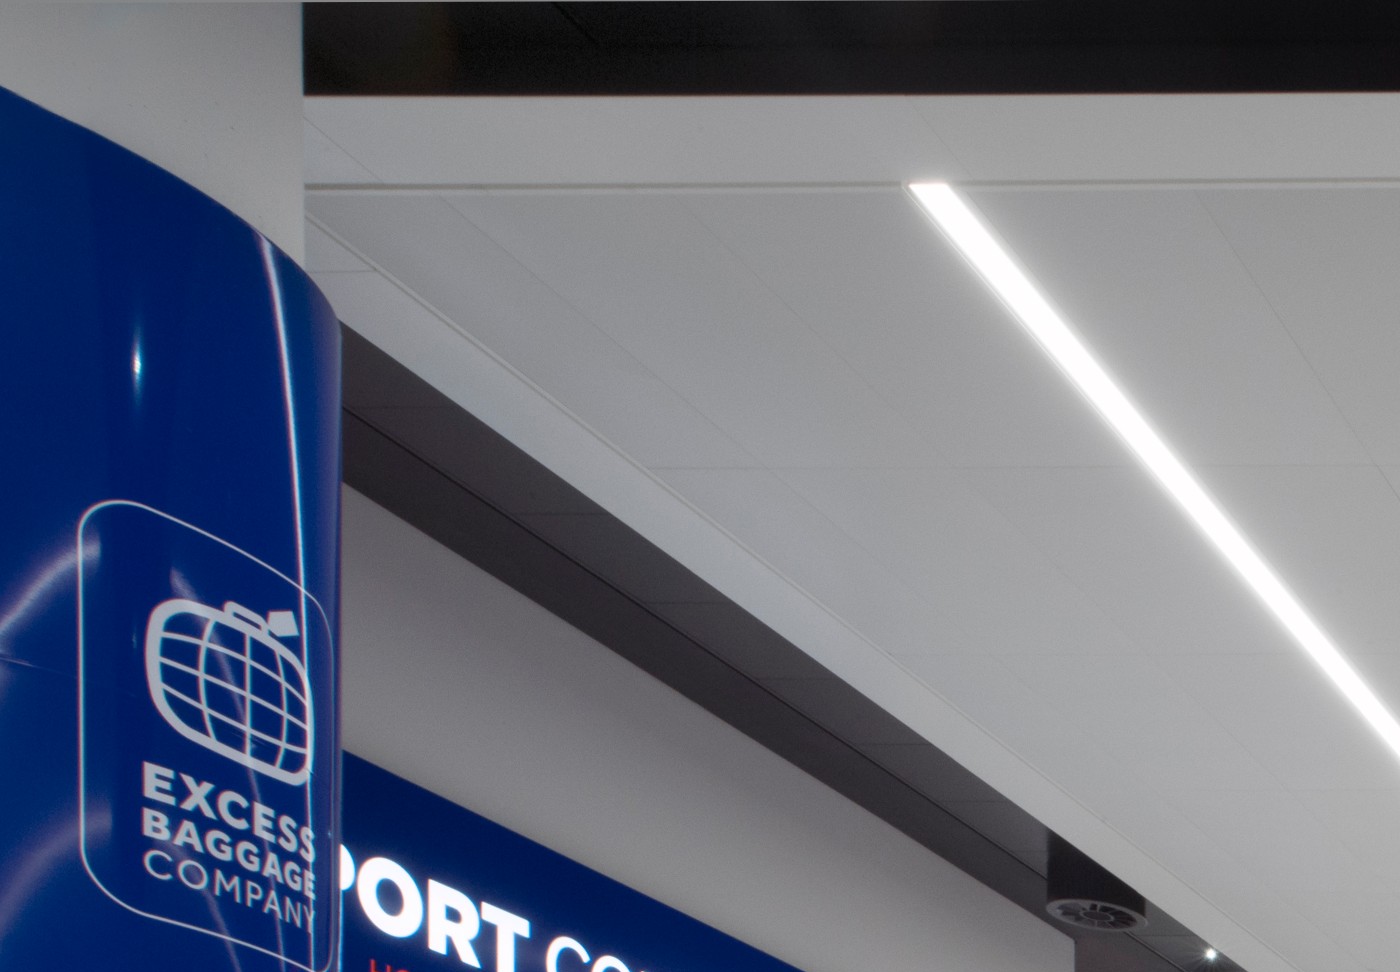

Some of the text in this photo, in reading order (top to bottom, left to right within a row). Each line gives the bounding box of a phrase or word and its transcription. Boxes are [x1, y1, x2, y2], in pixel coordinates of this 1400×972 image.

[142, 806, 316, 900] BAGGAGE
[143, 761, 315, 862] EXCESS
[143, 850, 315, 933] COMPANY
